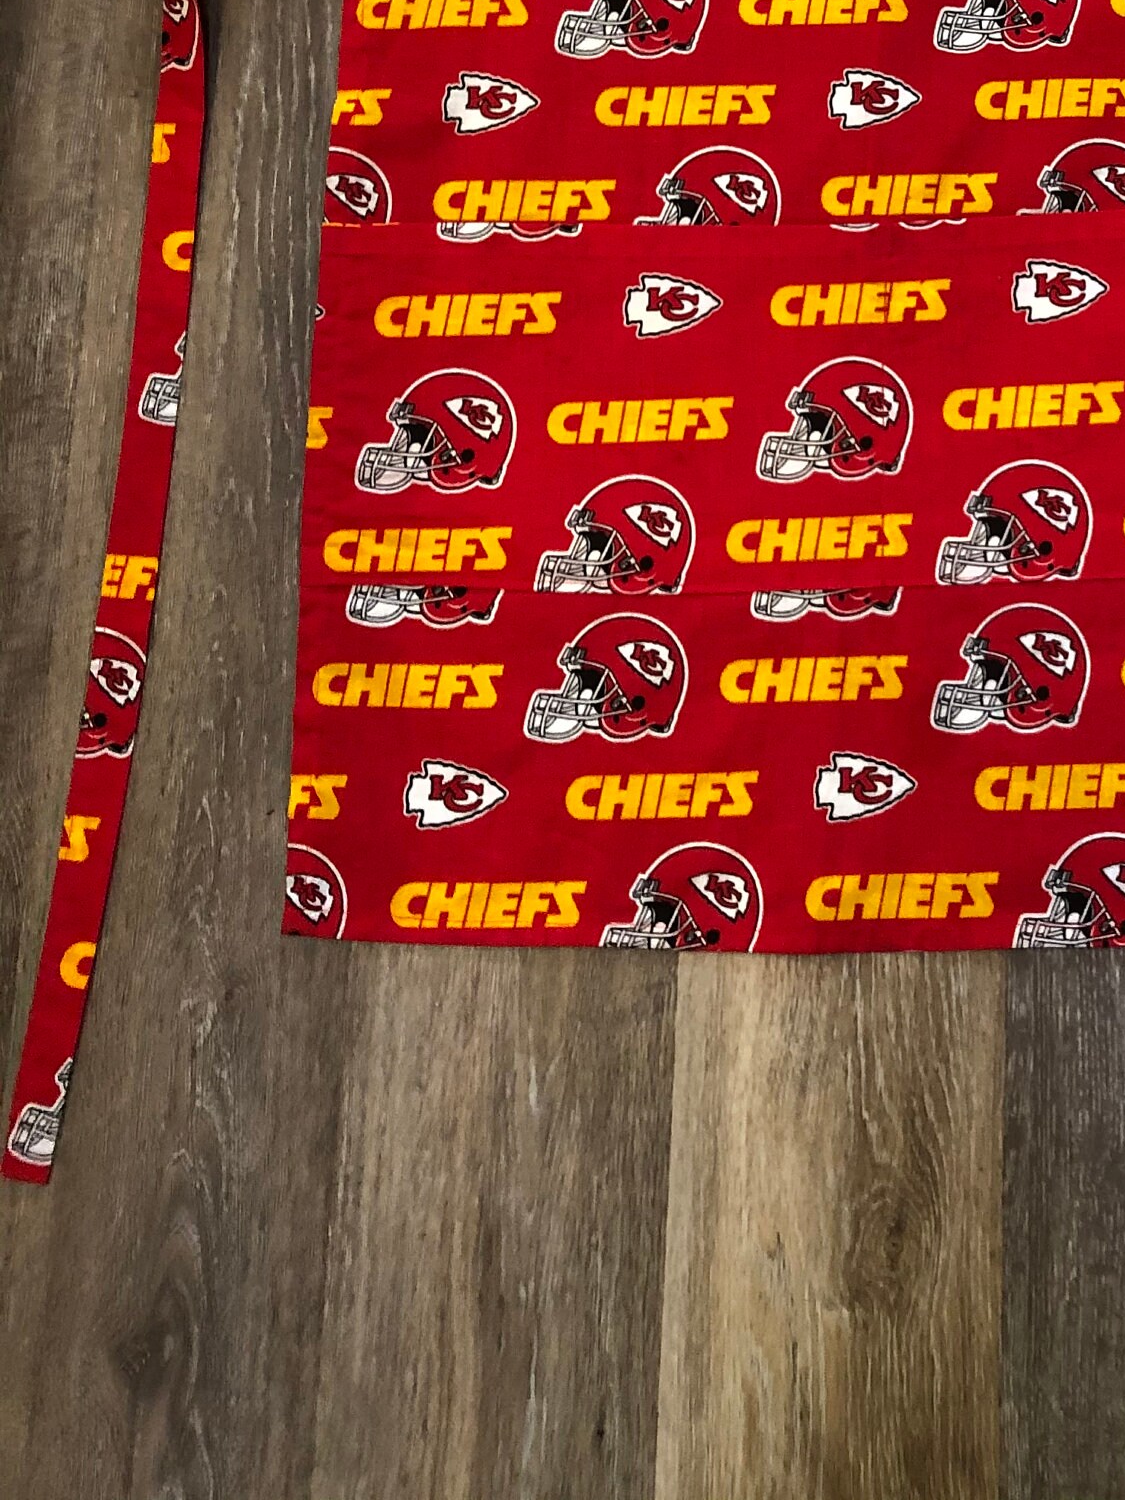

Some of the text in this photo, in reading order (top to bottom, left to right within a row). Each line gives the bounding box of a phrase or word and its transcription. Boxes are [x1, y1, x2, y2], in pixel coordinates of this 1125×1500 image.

[466, 86, 517, 119] KC
[595, 84, 776, 127] CHIEFS
[850, 81, 899, 115] KC
[432, 179, 616, 222] CHIEFS
[821, 172, 998, 216] CHIEFS
[646, 287, 699, 321] KC
[770, 278, 951, 327] CHIEFS
[1034, 272, 1086, 307] KC
[374, 291, 562, 337] CHIEFS
[547, 396, 734, 445] CHIEFS
[942, 381, 1125, 431] CHIEFS
[323, 526, 513, 572] CHIEFS
[726, 513, 913, 563] CHIEFS
[312, 663, 504, 709] CHIEFS
[719, 655, 908, 703] CHIEFS
[428, 775, 483, 813] KC
[565, 771, 759, 820] CHIEFS
[838, 767, 893, 804] KC
[390, 881, 587, 928] CHIEFS
[805, 871, 999, 921] CHIEFS
